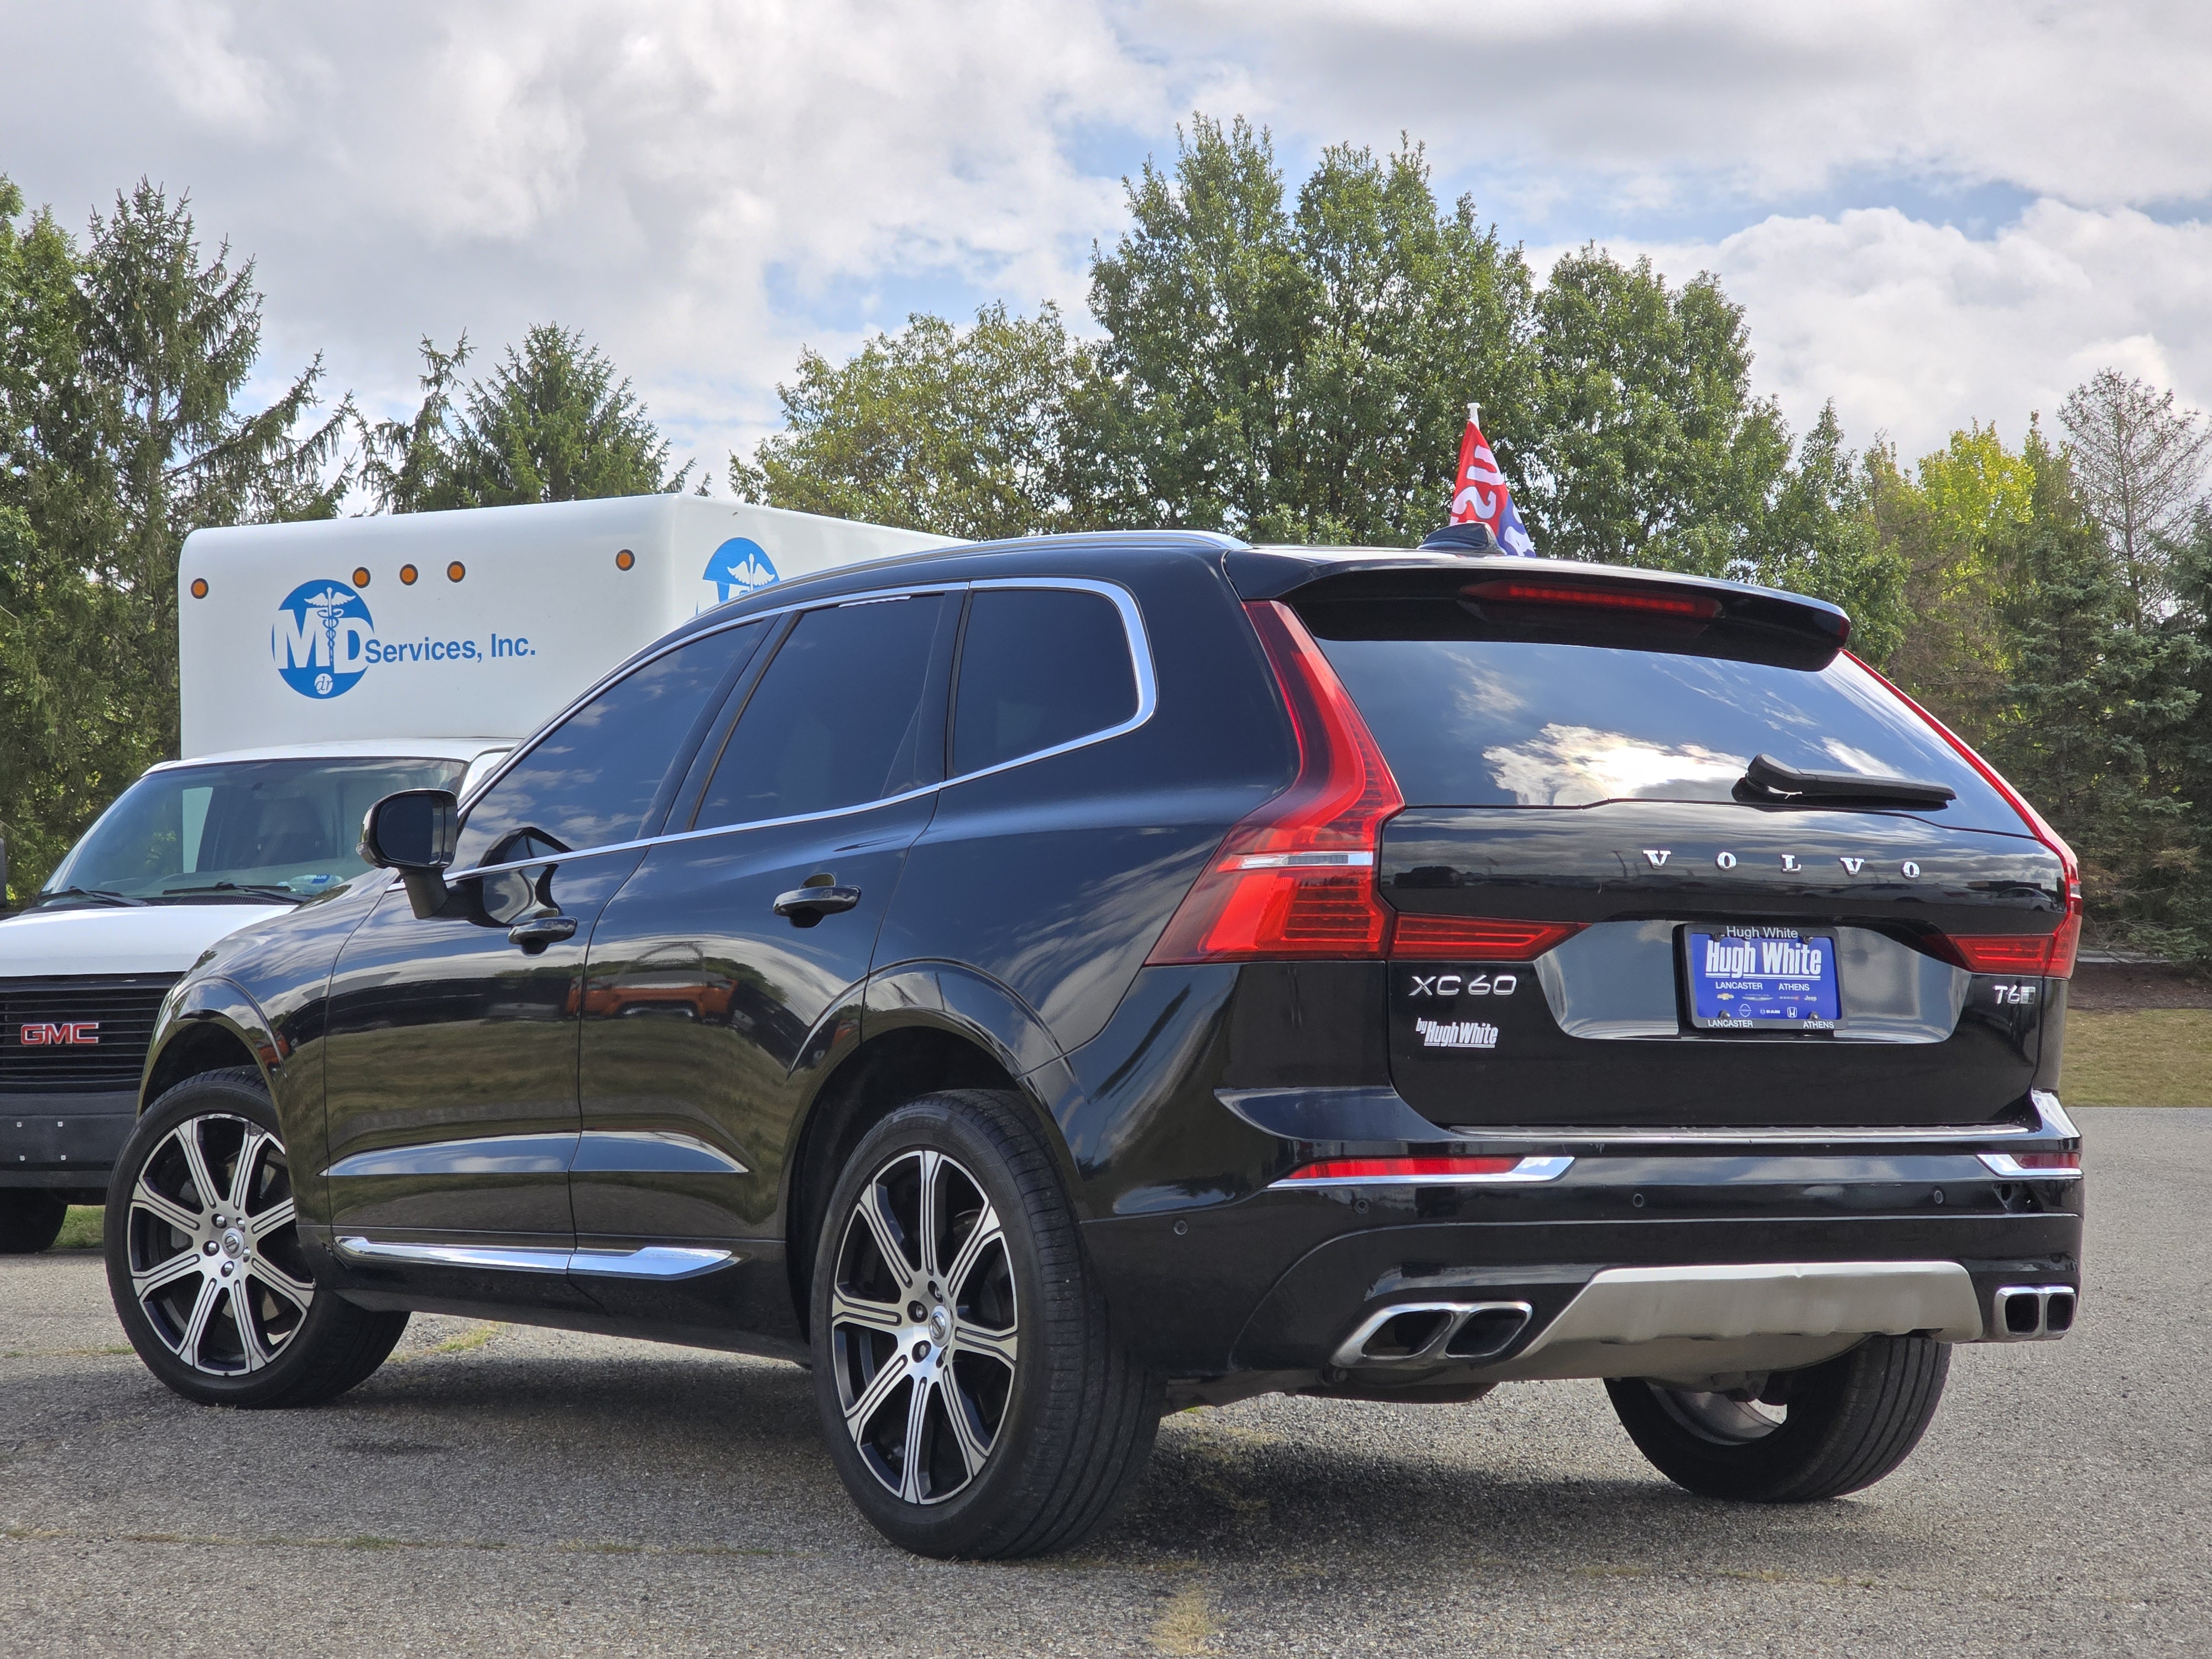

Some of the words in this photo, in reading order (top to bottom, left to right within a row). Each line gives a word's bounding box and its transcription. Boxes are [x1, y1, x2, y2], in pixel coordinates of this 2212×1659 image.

[364, 637, 483, 664] Services,
[491, 633, 536, 658] Inc.
[315, 676, 333, 691] dr
[1643, 850, 1921, 879] VOLVO
[1726, 926, 1760, 940] Hugh
[1763, 927, 1798, 938] White
[1705, 940, 1756, 978] Hugh
[1762, 942, 1822, 975] White
[1715, 982, 1763, 990] LANCASTER
[1778, 983, 1810, 992] ATHENS
[1994, 984, 2020, 1004] T6
[20, 1022, 99, 1045] GMC
[1416, 1018, 1428, 1034] by
[1425, 1021, 1460, 1047] Hugh
[1459, 1022, 1499, 1044] White
[1708, 1019, 1754, 1028] LANCASTER
[1803, 1021, 1834, 1029] ATHENS
